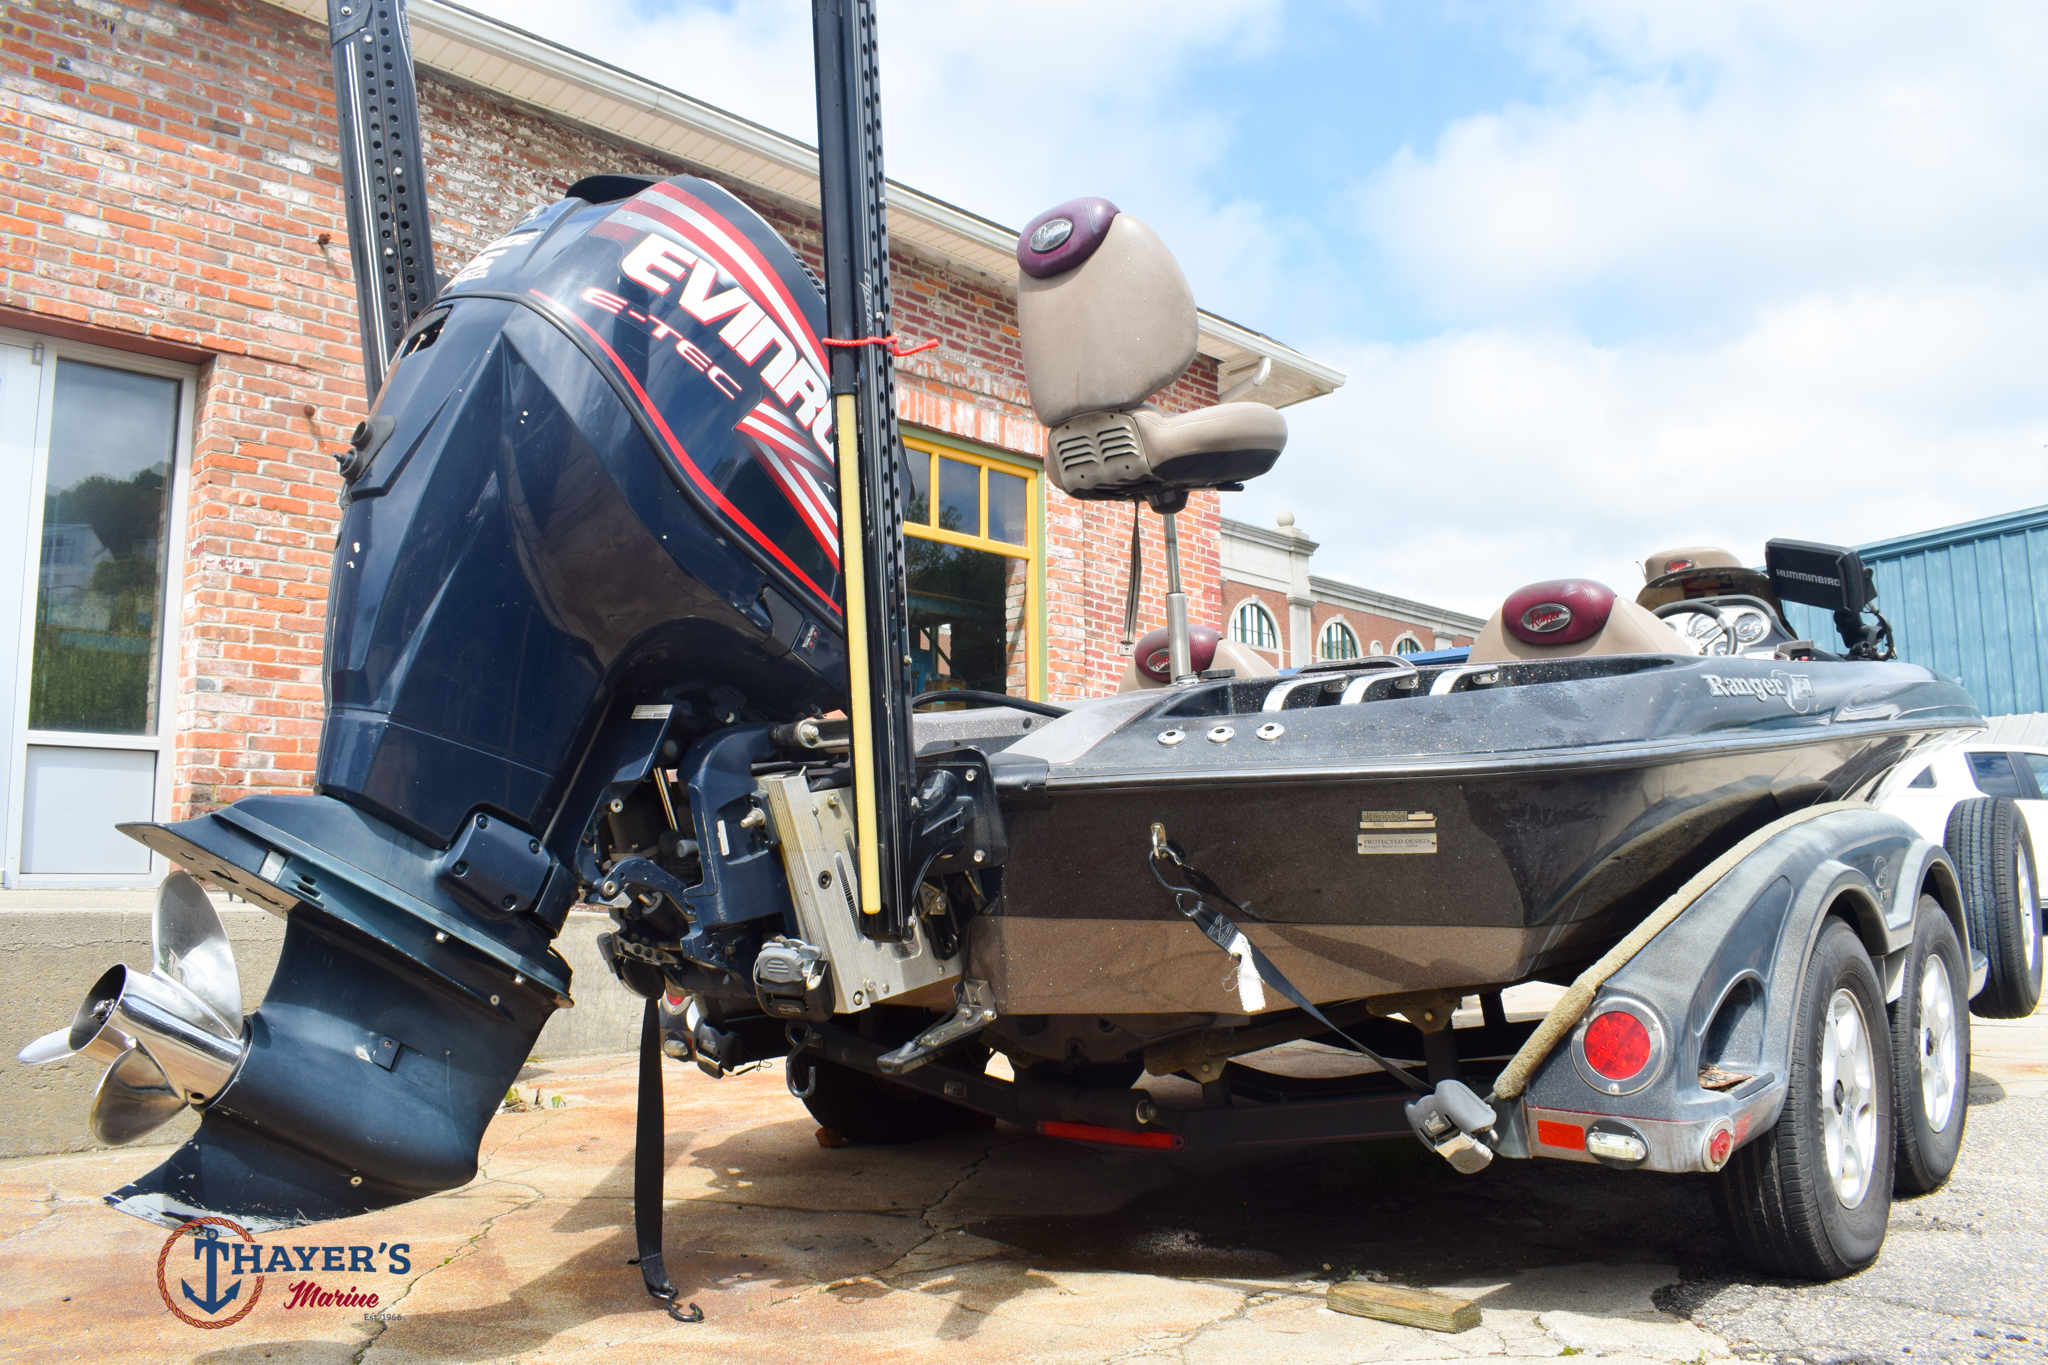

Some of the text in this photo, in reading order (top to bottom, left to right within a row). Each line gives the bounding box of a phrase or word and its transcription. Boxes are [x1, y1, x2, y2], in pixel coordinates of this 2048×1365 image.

[581, 287, 742, 400] E-TEC
[1775, 568, 1841, 587] HUMMINBIRD
[1529, 608, 1563, 629] Ranger
[1699, 674, 1787, 703] Ranger
[1816, 1021, 1825, 1075] KING
